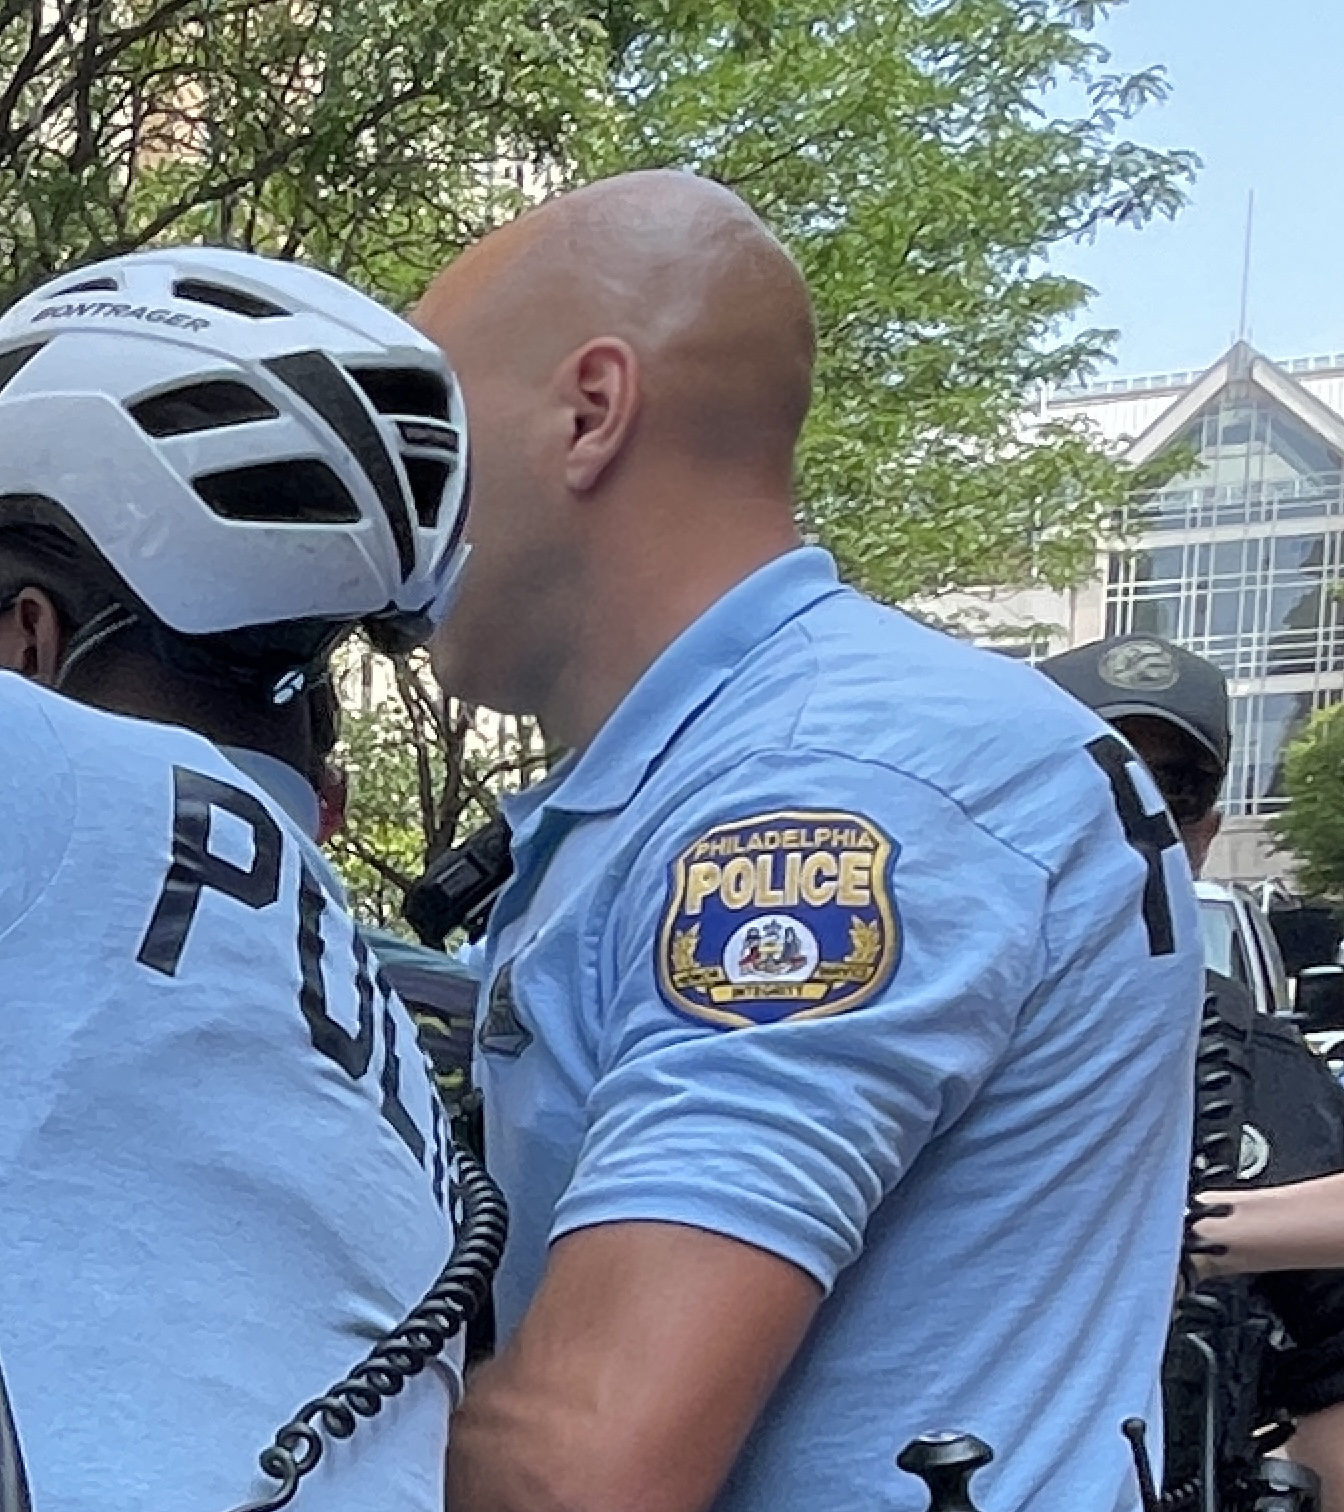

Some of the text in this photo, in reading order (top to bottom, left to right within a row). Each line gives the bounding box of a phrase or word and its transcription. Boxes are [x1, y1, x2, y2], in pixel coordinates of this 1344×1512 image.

[31, 302, 211, 332] BONTRAGER
[693, 827, 876, 859] PHILADELPHIA
[684, 850, 873, 916] POLICE
